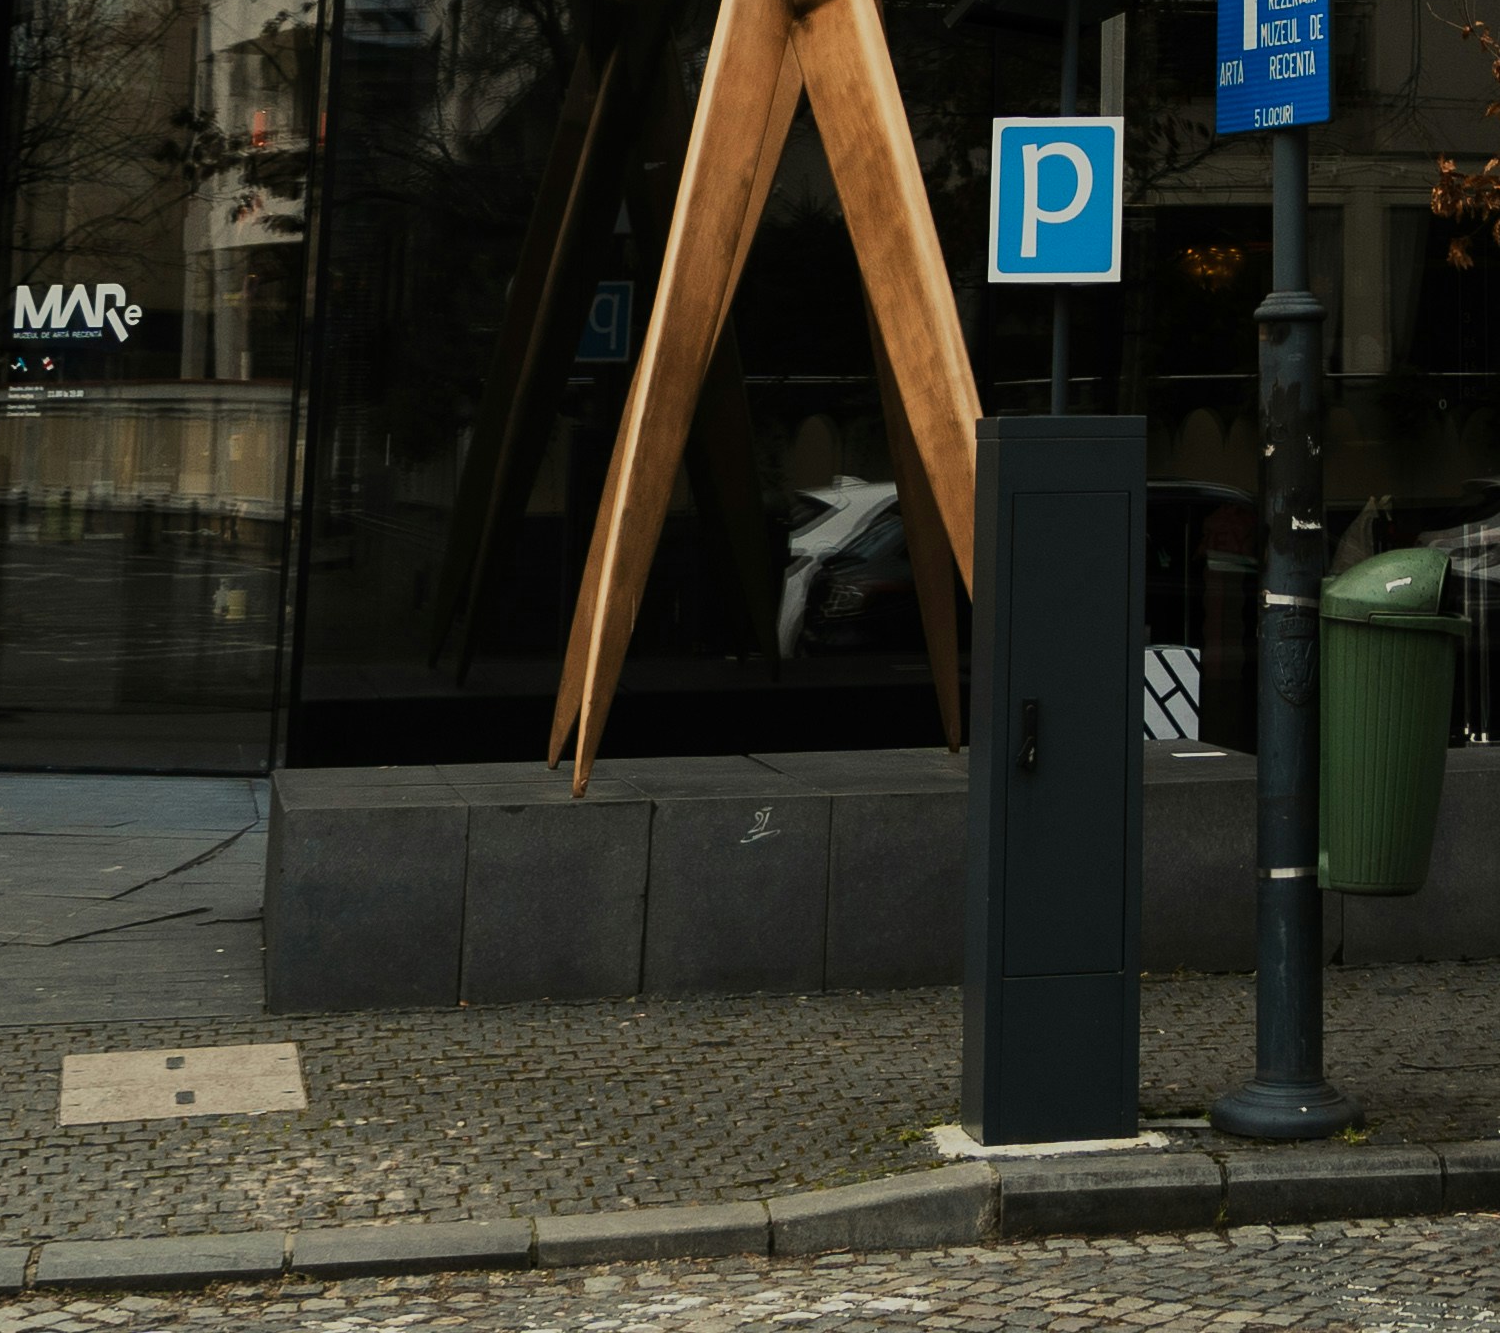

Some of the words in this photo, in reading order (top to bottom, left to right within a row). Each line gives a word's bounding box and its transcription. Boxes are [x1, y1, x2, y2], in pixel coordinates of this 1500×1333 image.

[1260, 17, 1302, 49] MUZEUL
[1309, 13, 1324, 41] DE
[1254, 108, 1261, 128] 5
